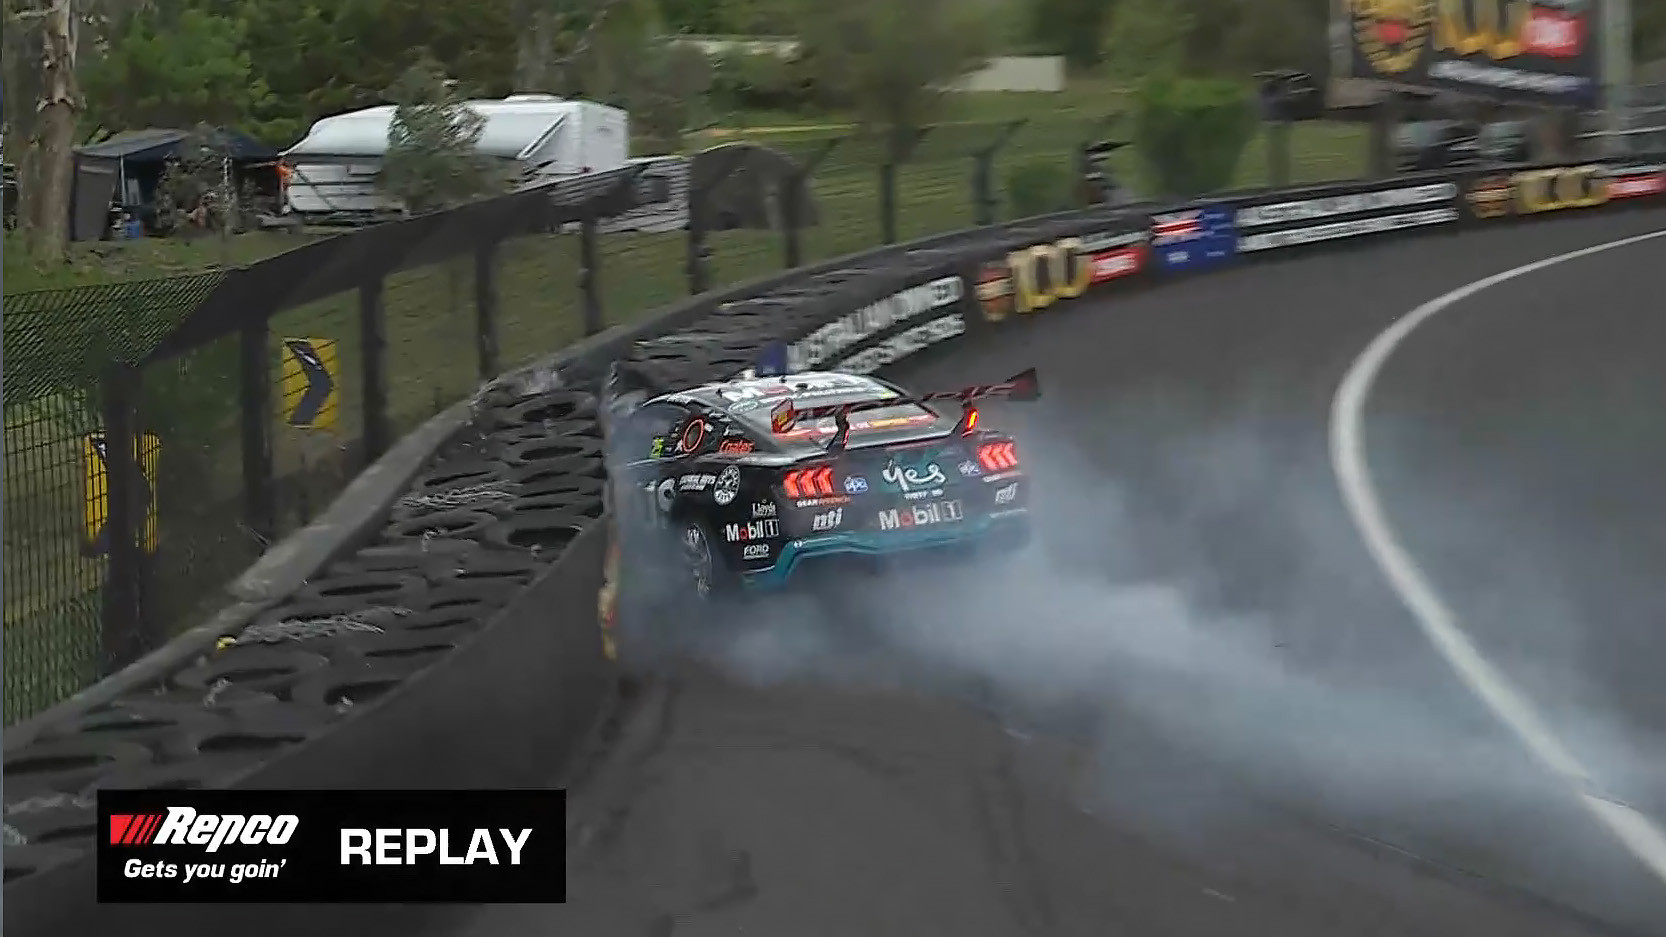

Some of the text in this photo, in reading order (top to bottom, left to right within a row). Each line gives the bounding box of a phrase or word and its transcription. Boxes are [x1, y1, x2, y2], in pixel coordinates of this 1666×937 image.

[882, 459, 946, 492] yes
[879, 501, 940, 531] Mobil
[725, 521, 764, 542] Mobil
